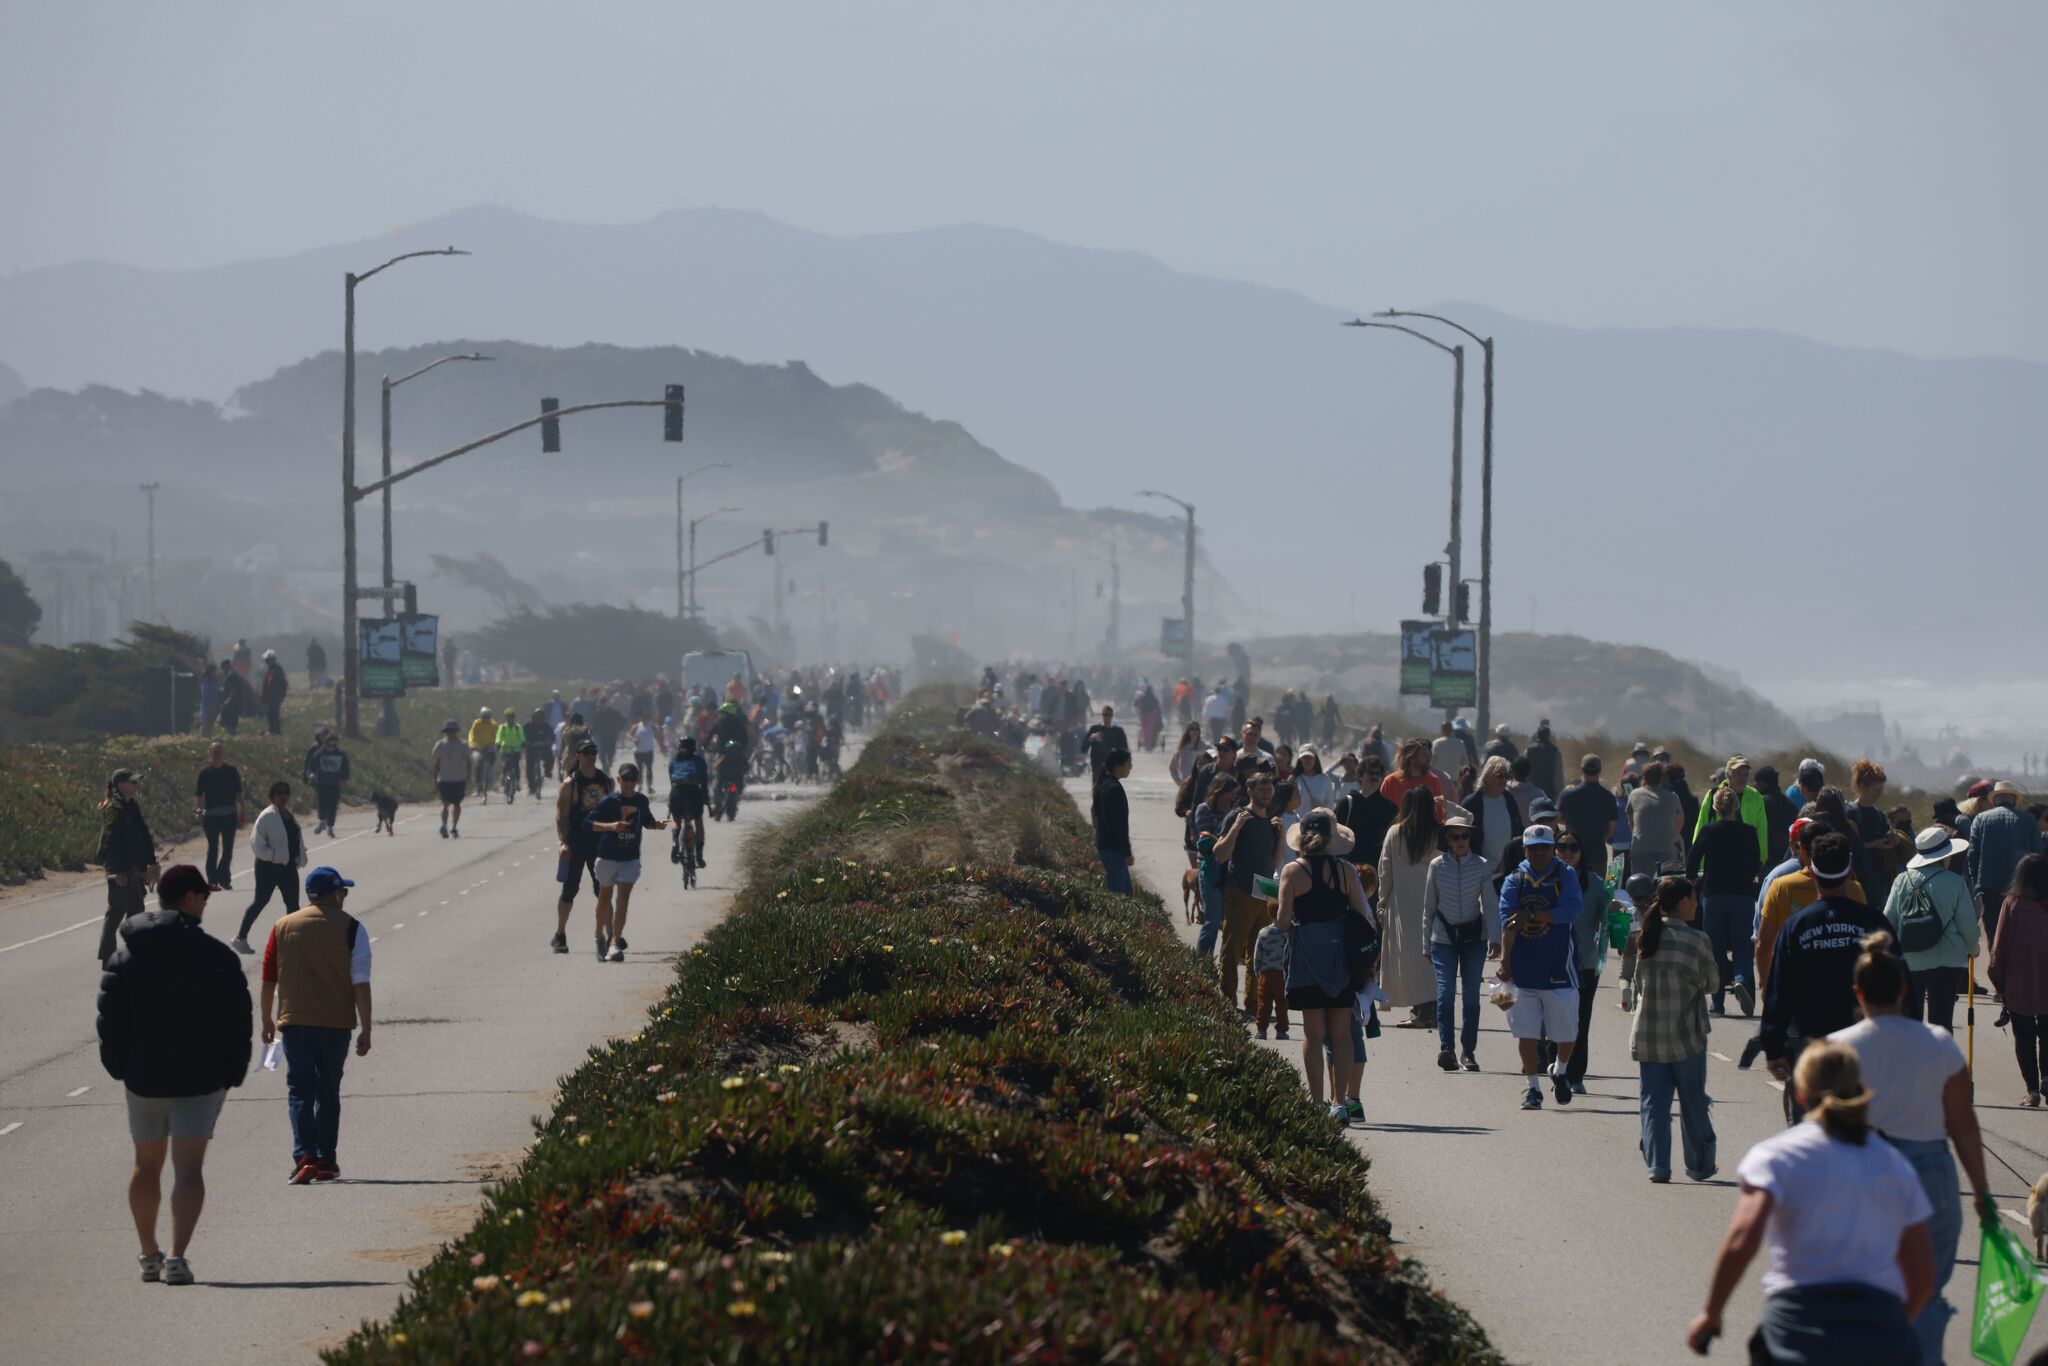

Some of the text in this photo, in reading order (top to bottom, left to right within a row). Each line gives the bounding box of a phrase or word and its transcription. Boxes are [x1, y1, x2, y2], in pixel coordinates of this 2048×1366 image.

[1799, 923, 1865, 945] NEW YORK'S
[1813, 937, 1851, 949] FINEST
